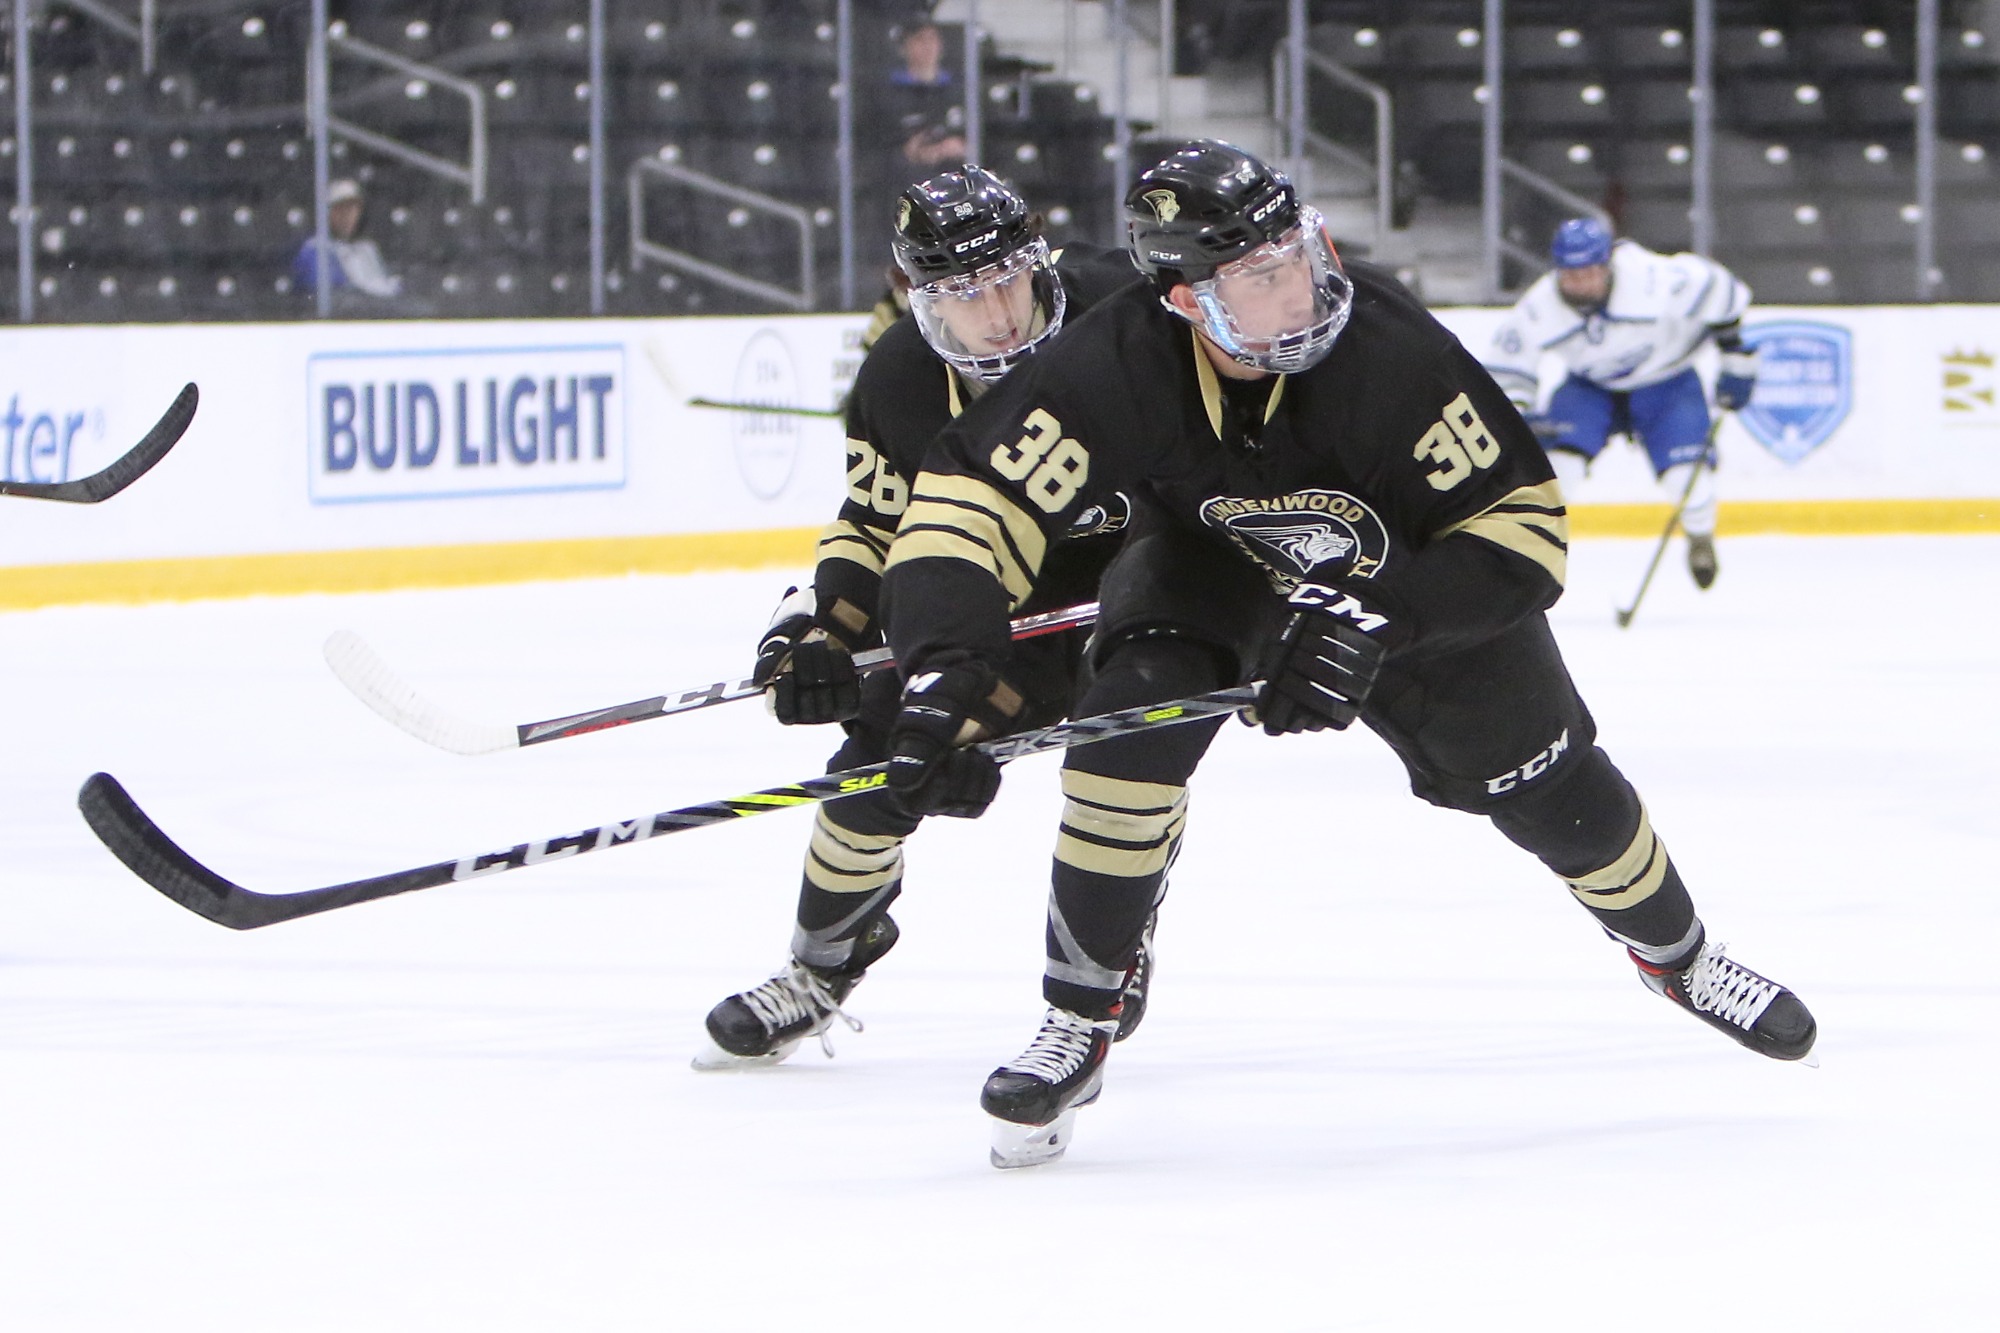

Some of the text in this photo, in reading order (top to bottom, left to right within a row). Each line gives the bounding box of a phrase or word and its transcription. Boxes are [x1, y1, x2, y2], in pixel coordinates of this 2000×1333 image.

[1253, 190, 1287, 222] CCM
[955, 229, 998, 253] CCM
[1149, 250, 1182, 261] CCM
[324, 374, 614, 472] BUD LIGHT
[1412, 391, 1502, 491] 38
[990, 408, 1090, 514] 38
[1287, 583, 1389, 632] CM
[661, 676, 765, 713] CC
[1485, 728, 1569, 796] CCM
[452, 813, 657, 882] CCM
